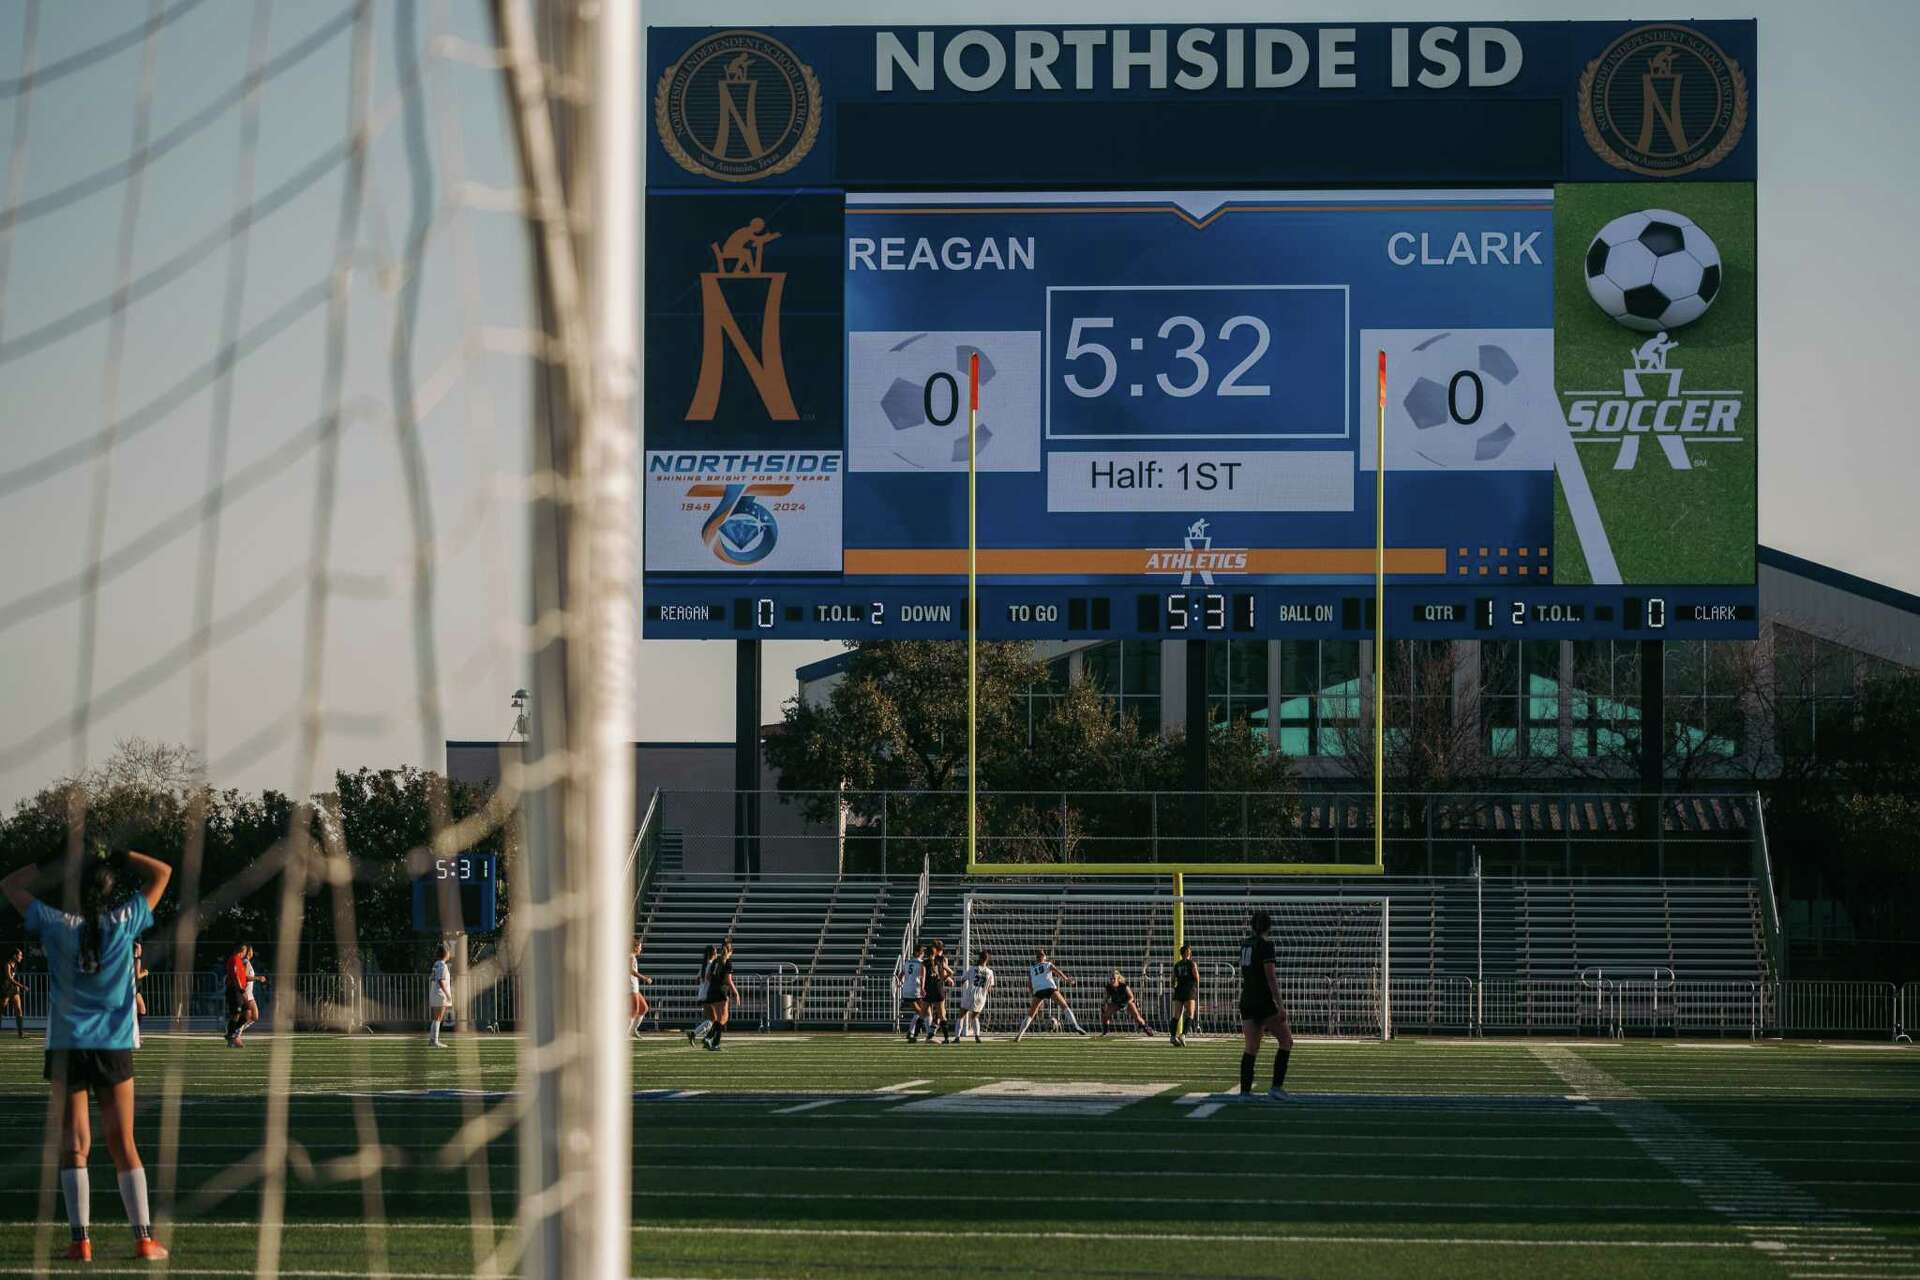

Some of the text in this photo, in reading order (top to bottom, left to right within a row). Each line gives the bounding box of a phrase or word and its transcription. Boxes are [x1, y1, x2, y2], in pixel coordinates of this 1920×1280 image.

[684, 36, 761, 69] INDEPENDENT
[875, 25, 1524, 92] NORTHSIDE ISD
[848, 237, 1035, 271] REAGAN
[1387, 231, 1543, 266] CLARK
[1062, 315, 1272, 399] 5:32
[923, 371, 959, 427] 0
[1447, 369, 1484, 426] 0
[1566, 399, 1742, 433] SOCCER
[649, 454, 841, 473] NORTHSIDE
[1091, 460, 1243, 491] Half: 1ST
[681, 502, 711, 511] 1949
[773, 502, 807, 512] 2024
[1144, 552, 1248, 570] ATHLETICS
[660, 605, 709, 621] REAGAN
[757, 598, 774, 628] 0
[817, 602, 884, 625] T.O.L. 2
[901, 605, 951, 622] DOWN
[1008, 604, 1058, 622] TO GO
[1167, 593, 1255, 630] 5:31
[1279, 604, 1333, 622] BALL ON
[1425, 600, 1493, 626] QTR 1
[1512, 601, 1581, 625] 2 T.O.L.
[1647, 598, 1665, 628] 0
[1694, 605, 1736, 621] CLARK
[435, 859, 489, 879] 5:31
